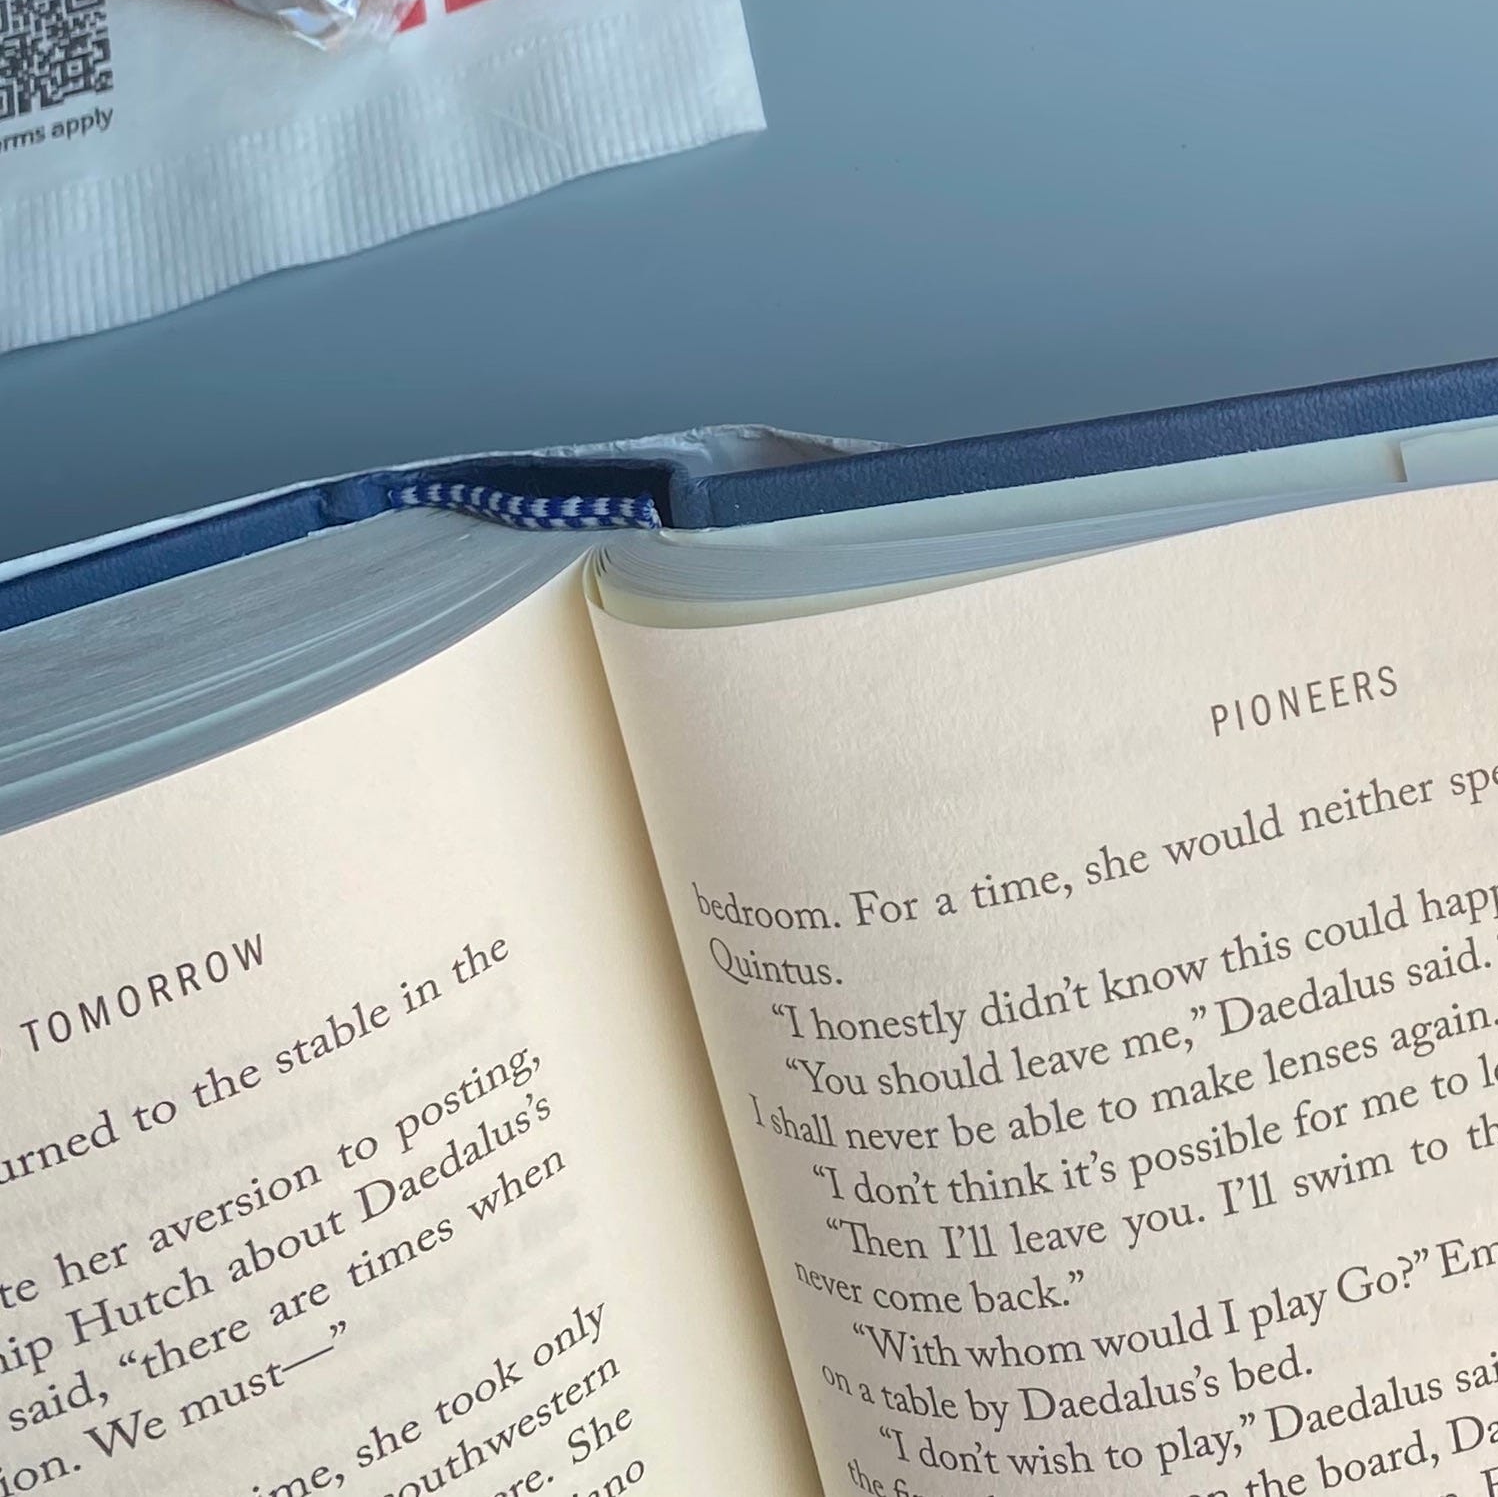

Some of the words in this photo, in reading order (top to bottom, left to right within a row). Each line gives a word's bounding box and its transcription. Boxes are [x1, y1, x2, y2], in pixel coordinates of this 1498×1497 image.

[0, 124, 46, 155] rms
[51, 106, 114, 141] apply
[1209, 663, 1400, 739] PIONEERS
[690, 880, 842, 931] bedroom.
[847, 888, 920, 928] For
[969, 870, 1074, 910] time,
[1084, 843, 1151, 887] she
[1160, 801, 1286, 867] would
[1297, 776, 1435, 834] neither
[17, 931, 264, 1054] TOMORROW
[708, 936, 844, 987] Quintus.
[808, 997, 968, 1046] honestly
[979, 974, 1092, 1028] didn’t
[1096, 955, 1210, 1005] know
[1218, 930, 1293, 975] this
[1303, 892, 1411, 953] could
[876, 1048, 1006, 1097] should
[1009, 1041, 1112, 1083] leave
[1212, 966, 1396, 1038] Daedalus
[1405, 934, 1493, 988] said.
[130, 1099, 178, 1133] to
[190, 1064, 263, 1110] the
[274, 1000, 392, 1076] stable
[398, 978, 444, 1016] in
[450, 937, 510, 986] the
[769, 1104, 839, 1149] shall
[844, 1126, 941, 1152] never
[945, 1111, 998, 1149] be
[1007, 1096, 1088, 1142] able
[1096, 1096, 1139, 1125] to
[1149, 1061, 1256, 1114] make
[1261, 1034, 1379, 1087] lenses
[51, 1241, 129, 1291] her
[147, 1163, 324, 1255] aversion
[335, 1135, 379, 1170] to
[393, 1046, 542, 1156] posting,
[853, 1169, 940, 1206] don’t
[946, 1160, 1056, 1205] think
[1126, 1112, 1284, 1192] possible
[1292, 1097, 1350, 1140] for
[1359, 1084, 1421, 1122] me
[1428, 1071, 1470, 1102] to
[1007, 1219, 1109, 1256] leave
[1120, 1202, 1207, 1252] you.
[1292, 1151, 1396, 1199] swim
[1408, 1137, 1450, 1167] to
[63, 1265, 216, 1348] Hutch
[226, 1209, 347, 1285] about
[352, 1091, 552, 1225] Daedalus’s
[7, 1368, 110, 1433] said,
[117, 1318, 252, 1381] “there
[268, 1282, 332, 1328] are
[345, 1217, 455, 1289] times
[465, 1150, 568, 1222] when
[793, 1261, 864, 1306] never
[871, 1287, 964, 1315] come
[967, 1267, 1086, 1315] back.”
[963, 1332, 1087, 1369] whom
[1089, 1303, 1215, 1360] would
[1246, 1285, 1329, 1343] play
[1335, 1246, 1430, 1305] Go?”
[81, 1407, 168, 1459] We
[355, 1419, 423, 1470] she
[433, 1356, 525, 1426] took
[532, 1301, 606, 1368] only
[566, 1407, 634, 1467] She
[820, 1364, 854, 1397] on
[879, 1381, 960, 1421] table
[963, 1387, 1011, 1434] by
[1015, 1363, 1221, 1423] Daedalus’s
[1226, 1341, 1314, 1393] bed.
[917, 1435, 1001, 1476] don’t
[1005, 1439, 1097, 1477] wish
[1103, 1443, 1144, 1472] to
[1153, 1410, 1257, 1478] play,”
[1262, 1374, 1445, 1444] Daedalus
[846, 1457, 888, 1497] the
[1243, 1466, 1309, 1497] the
[1314, 1427, 1441, 1491] board,
